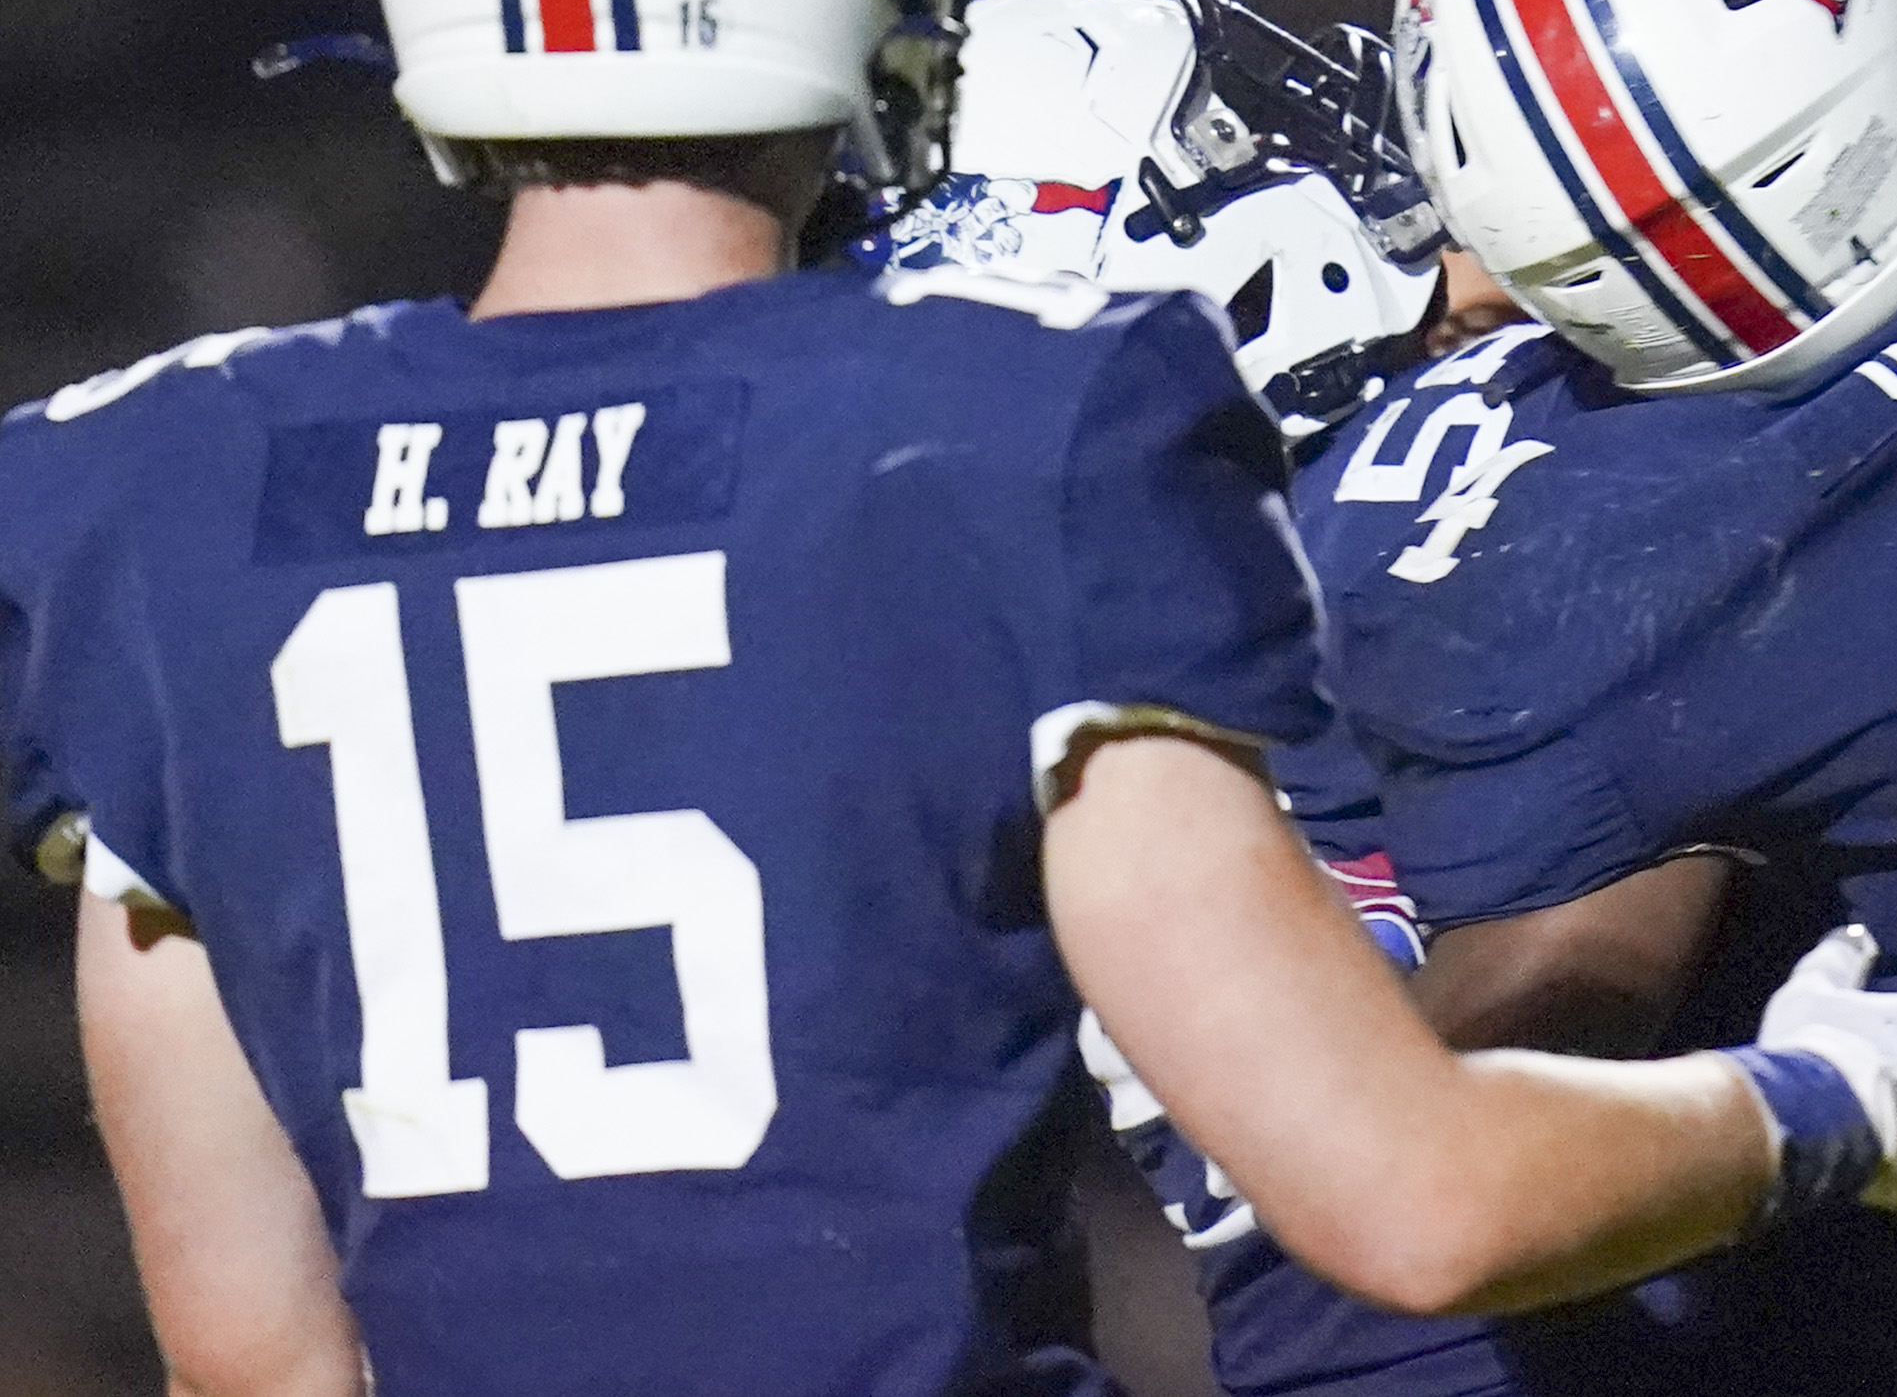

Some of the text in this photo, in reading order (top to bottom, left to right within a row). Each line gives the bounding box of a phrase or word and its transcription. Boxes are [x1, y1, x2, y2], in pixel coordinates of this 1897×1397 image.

[364, 402, 646, 536] H. RAY
[270, 550, 778, 1199] 15
